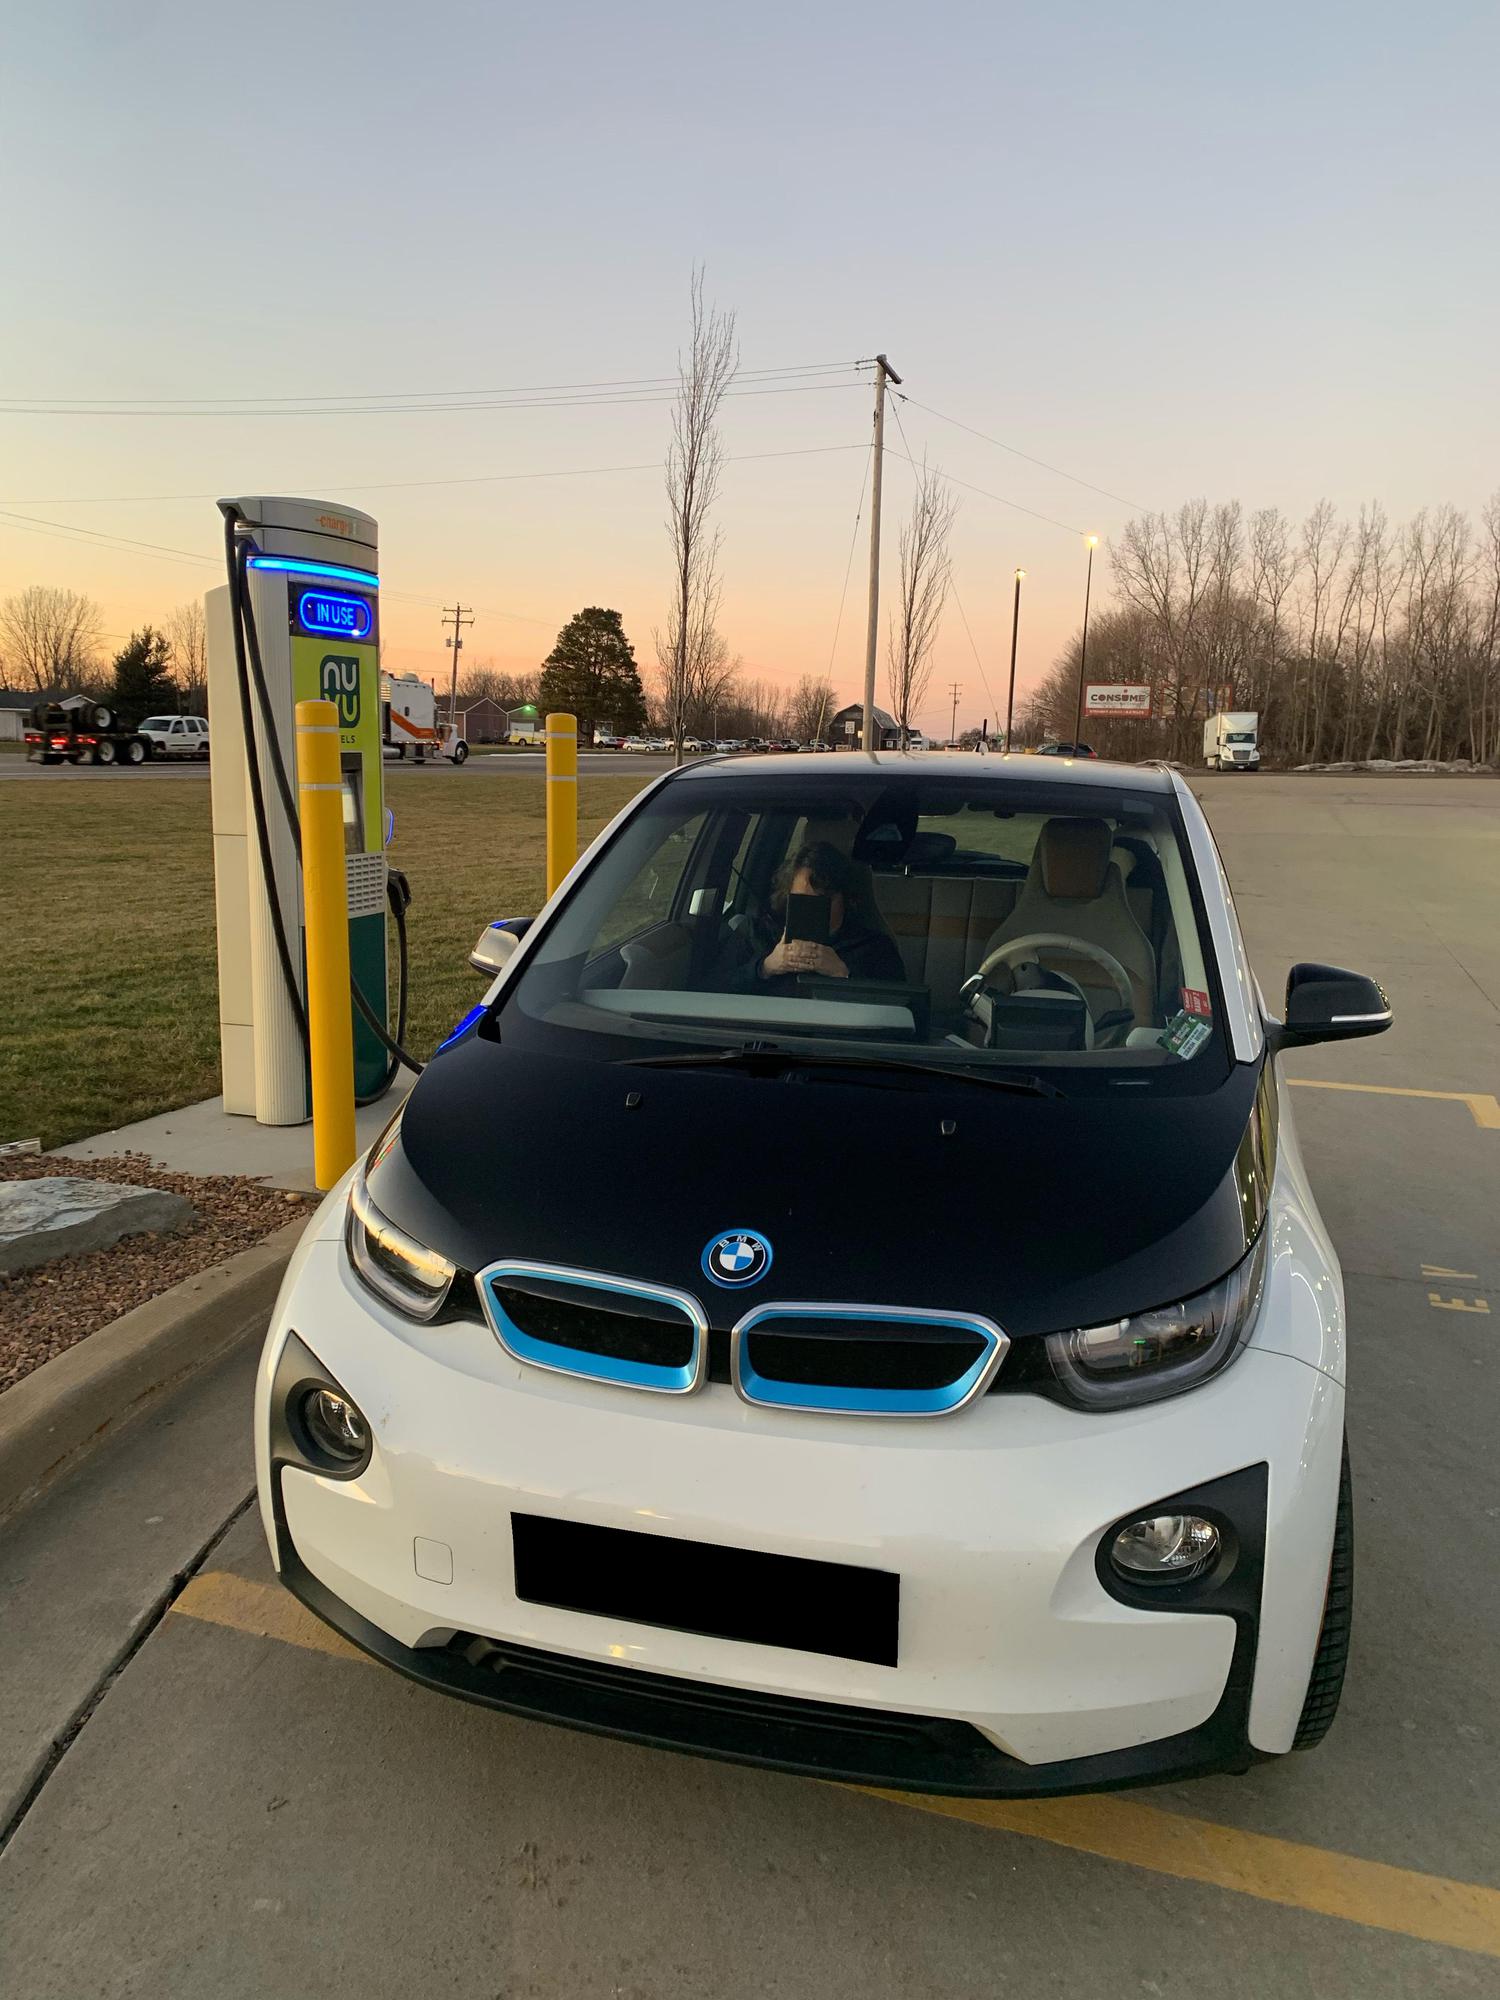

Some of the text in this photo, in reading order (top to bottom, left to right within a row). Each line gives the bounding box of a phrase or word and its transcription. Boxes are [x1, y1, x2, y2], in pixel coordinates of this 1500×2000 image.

[317, 603, 354, 626] IN USE
[1091, 694, 1146, 702] CONSUME
[718, 1235, 763, 1251] BMW
